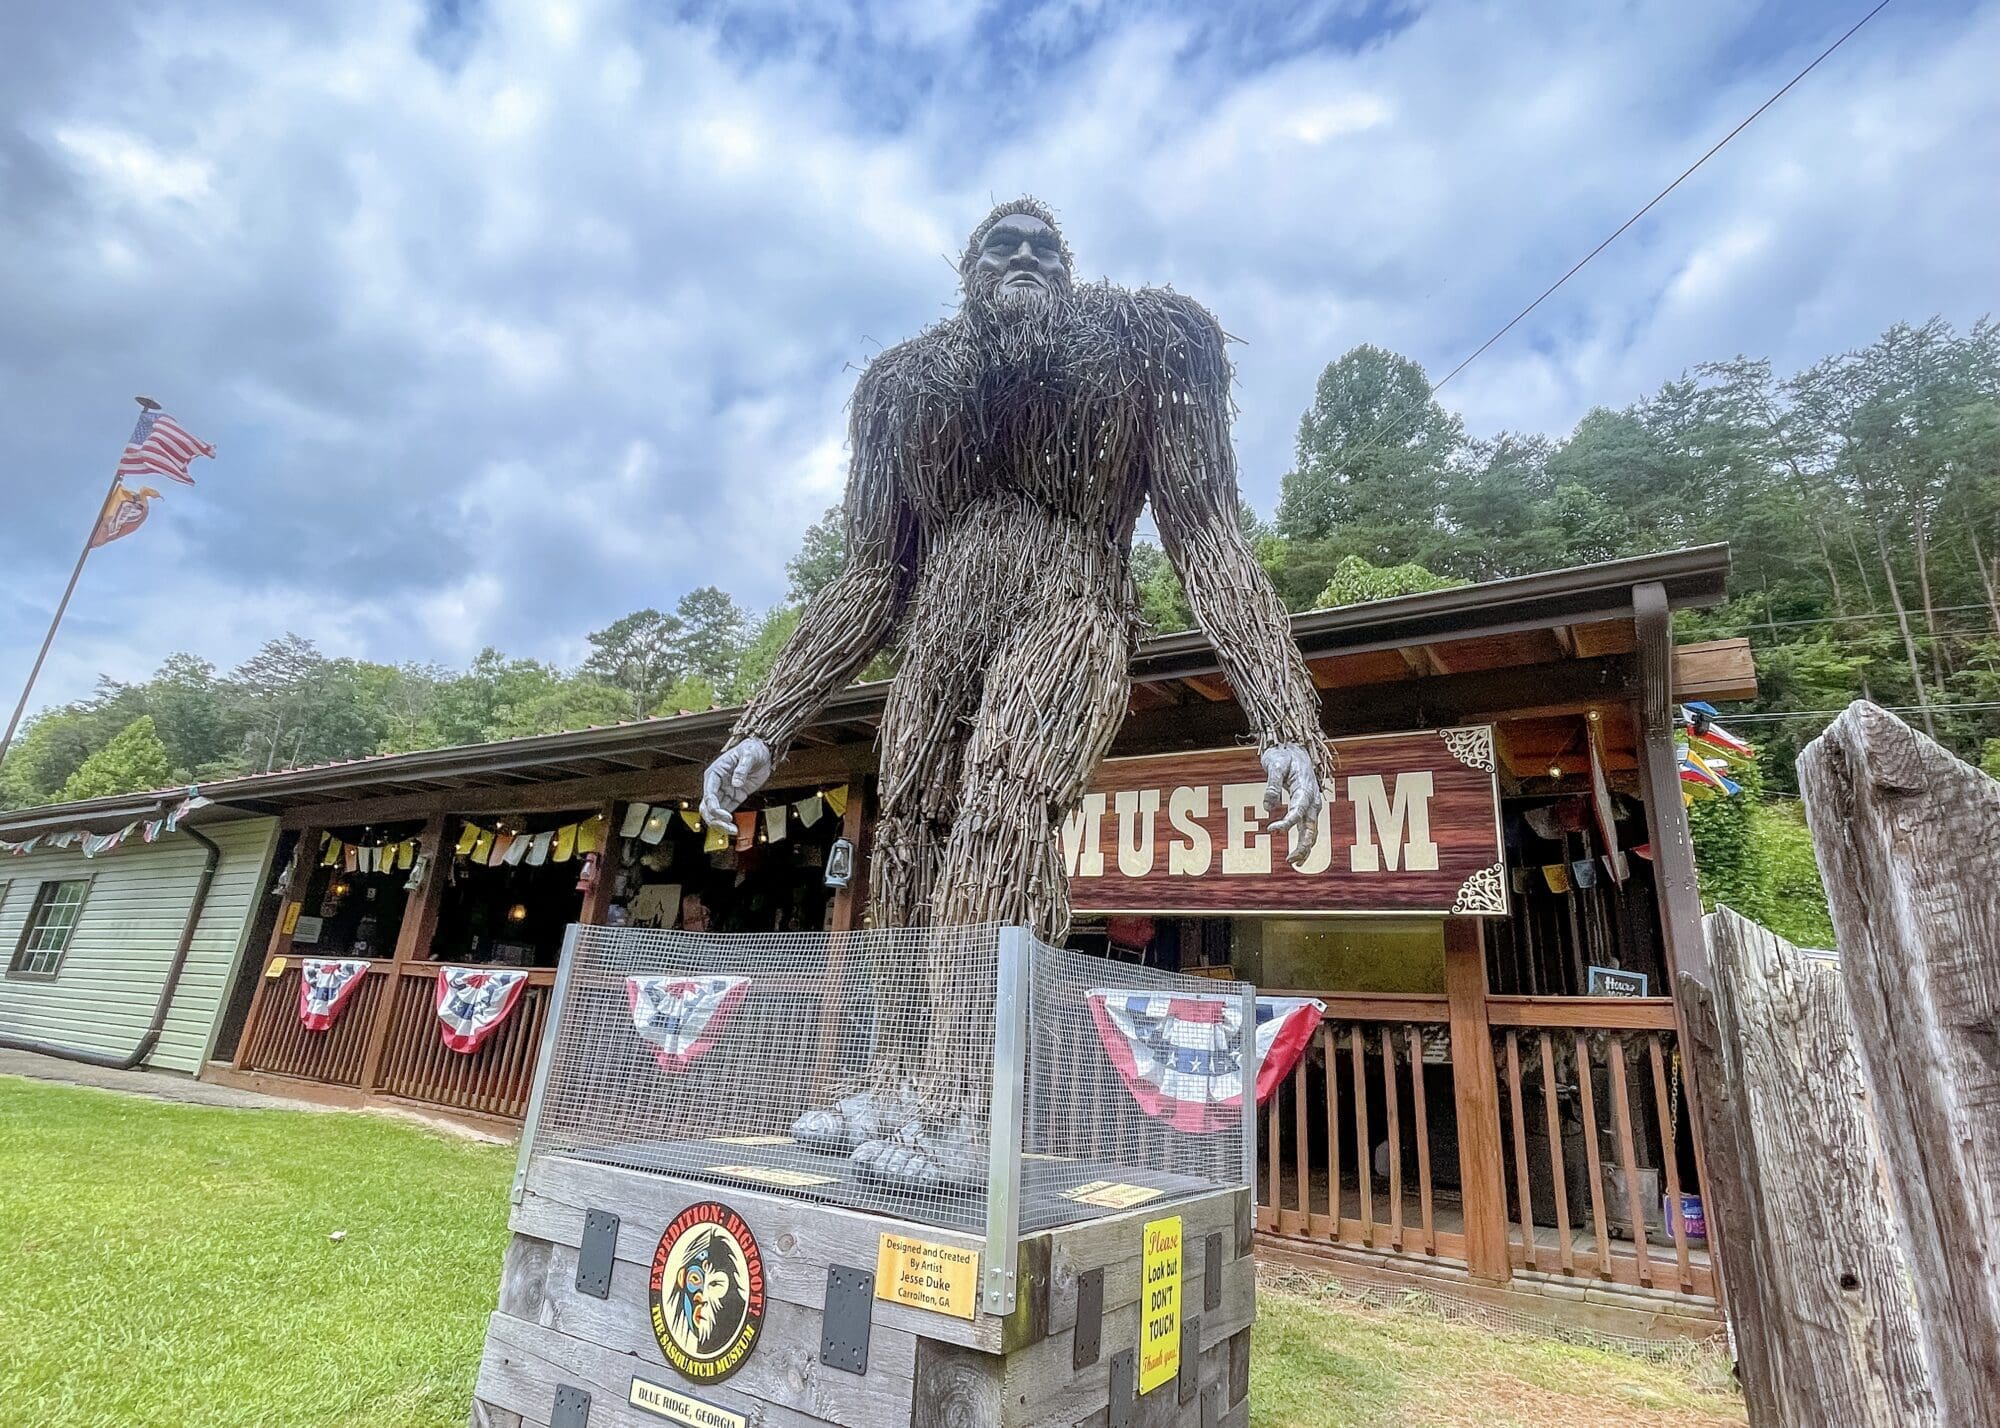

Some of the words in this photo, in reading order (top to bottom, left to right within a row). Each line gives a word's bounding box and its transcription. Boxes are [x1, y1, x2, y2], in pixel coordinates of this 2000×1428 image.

[1060, 771, 1439, 878] MUSEUM
[886, 1239, 922, 1254] Designed
[922, 1248, 938, 1258] and
[939, 1249, 971, 1264] Created
[1148, 1231, 1178, 1256] Please
[651, 1205, 724, 1291] EXPEDITION:
[726, 1213, 764, 1317] BIGFOOT!
[910, 1258, 920, 1271] By
[921, 1260, 943, 1274] Artist
[1148, 1261, 1165, 1284] Look
[1166, 1258, 1178, 1278] but
[900, 1270, 924, 1286] Jesse
[926, 1276, 951, 1291] Duke
[938, 1296, 951, 1308] GA
[1151, 1285, 1173, 1312] DON'T
[651, 1303, 663, 1337] THE
[659, 1332, 715, 1377] SASQUATCH
[715, 1324, 755, 1374] MUSEUM
[1149, 1312, 1174, 1342] TOUCH
[1142, 1348, 1163, 1375] Thank
[638, 1387, 662, 1406] BLUE
[662, 1395, 693, 1420] RIDGE,
[695, 1408, 736, 1428] GEORGIA
